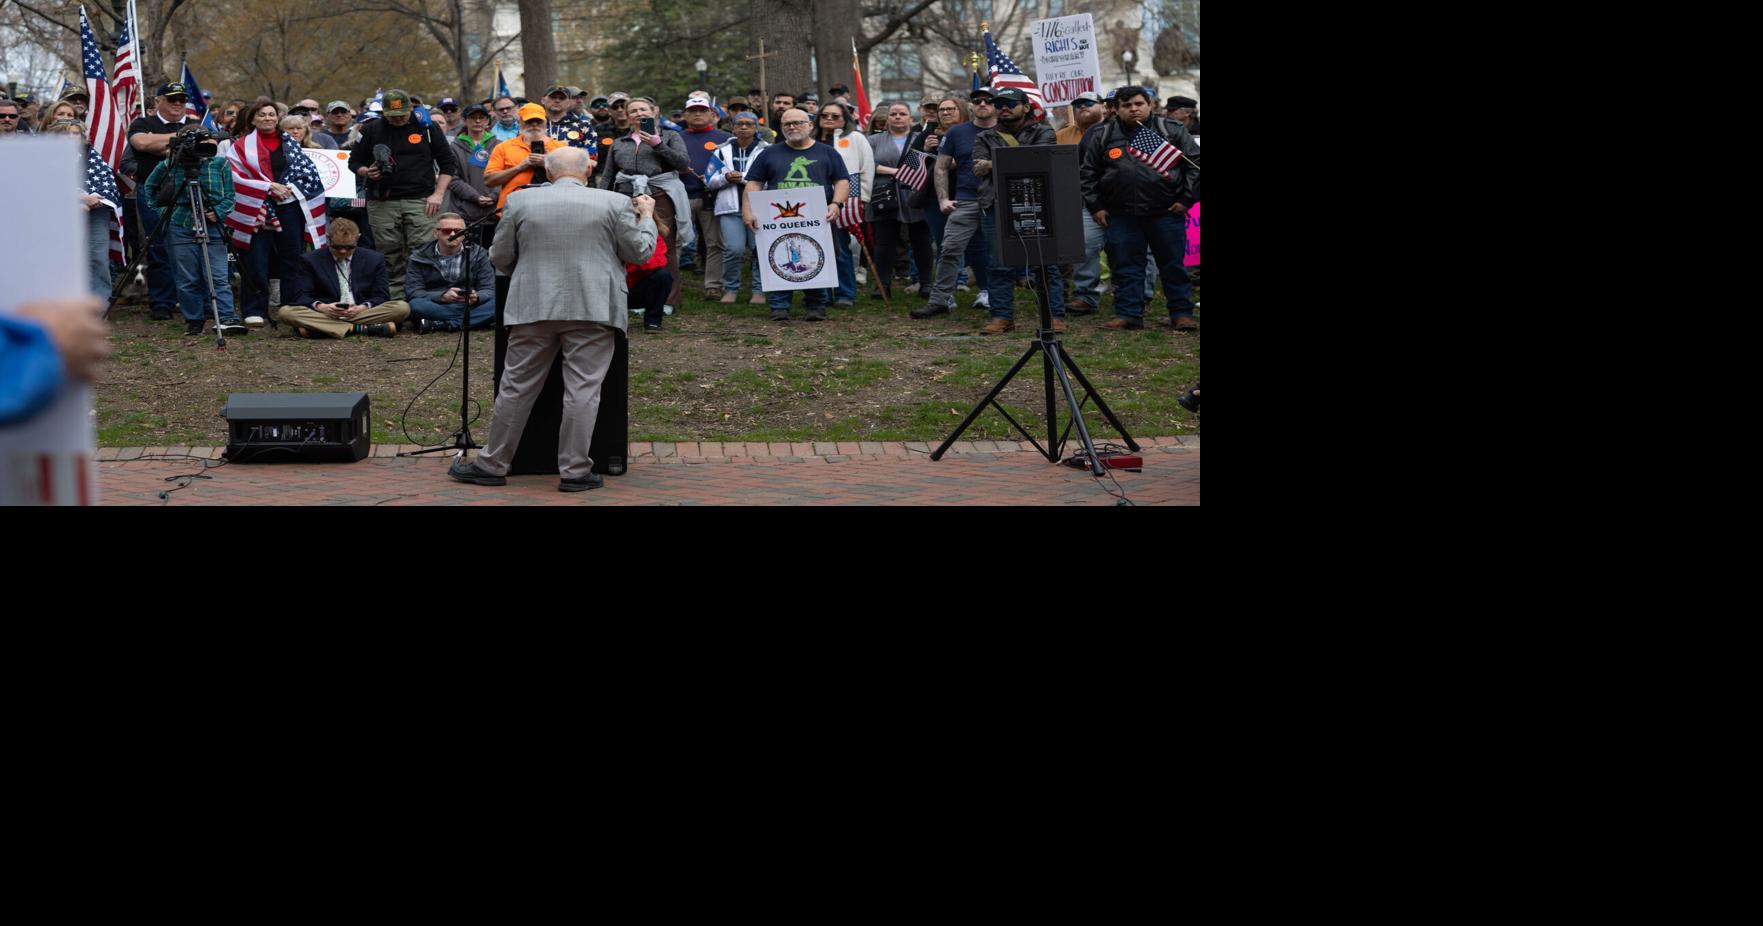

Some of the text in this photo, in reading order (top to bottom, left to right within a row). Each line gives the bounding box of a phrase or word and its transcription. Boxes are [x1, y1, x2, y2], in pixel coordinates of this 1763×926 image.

[1041, 21, 1062, 38] 1776
[1045, 38, 1078, 53] RIGHTS
[780, 220, 821, 229] QUEENS
